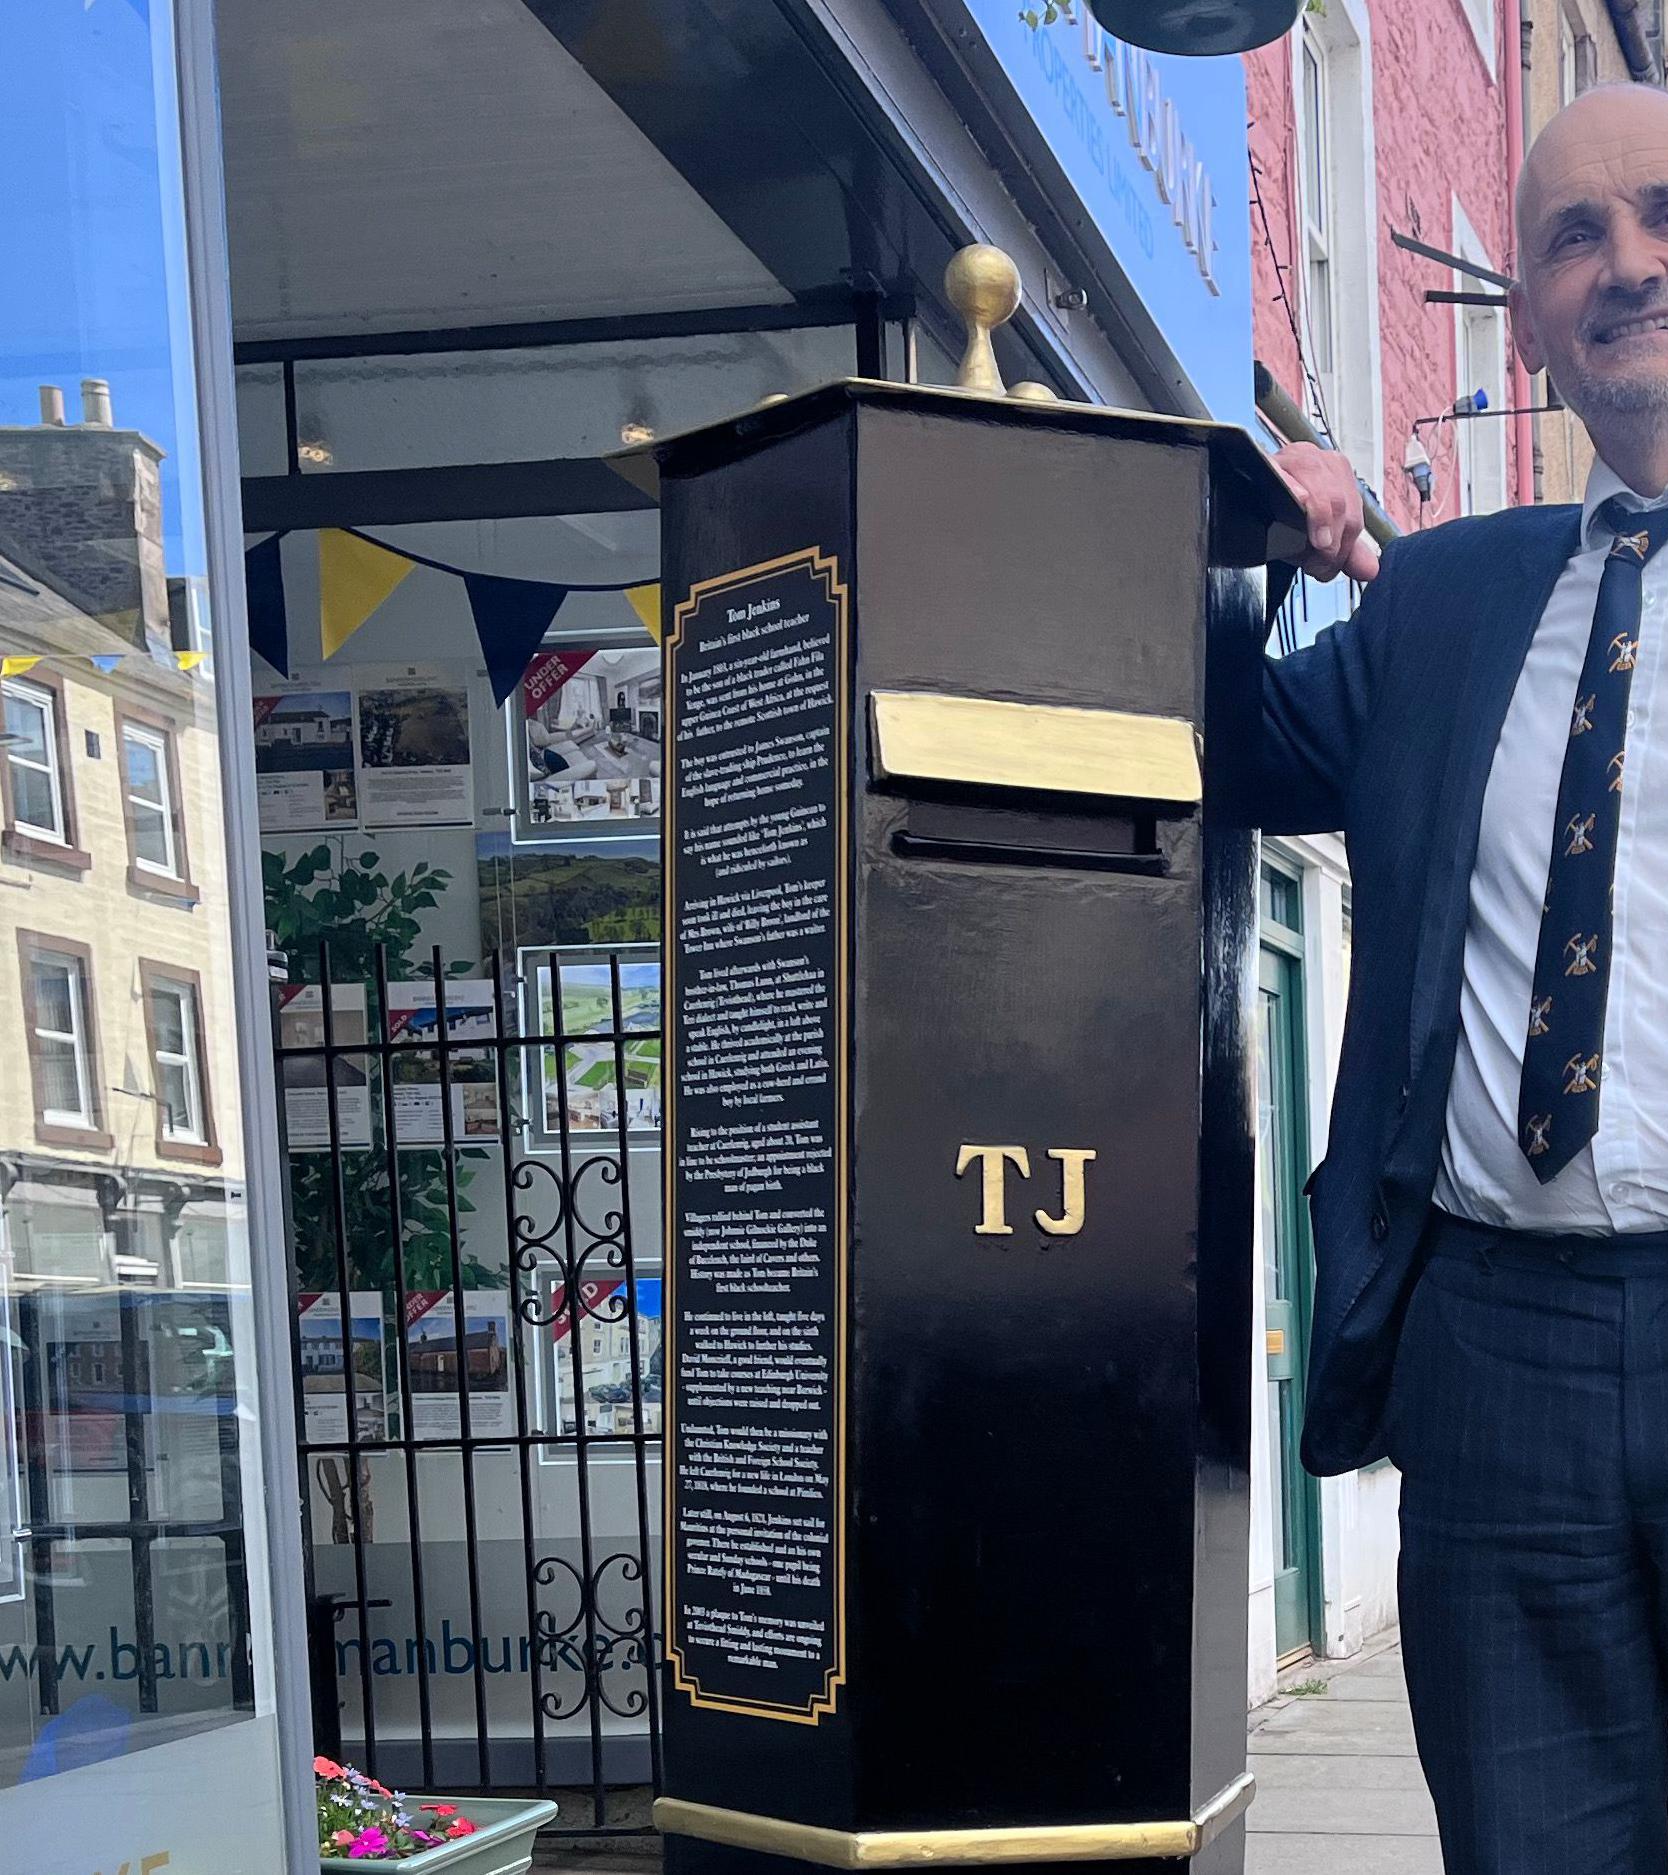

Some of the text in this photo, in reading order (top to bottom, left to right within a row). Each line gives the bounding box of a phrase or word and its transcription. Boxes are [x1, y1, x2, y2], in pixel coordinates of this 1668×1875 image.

[727, 599, 780, 623] Tom Jenkins
[700, 614, 809, 652] Britain's first black school teacher
[524, 655, 561, 689] UNDER
[531, 663, 569, 699] OFFER
[954, 1144, 1097, 1235] TJ
